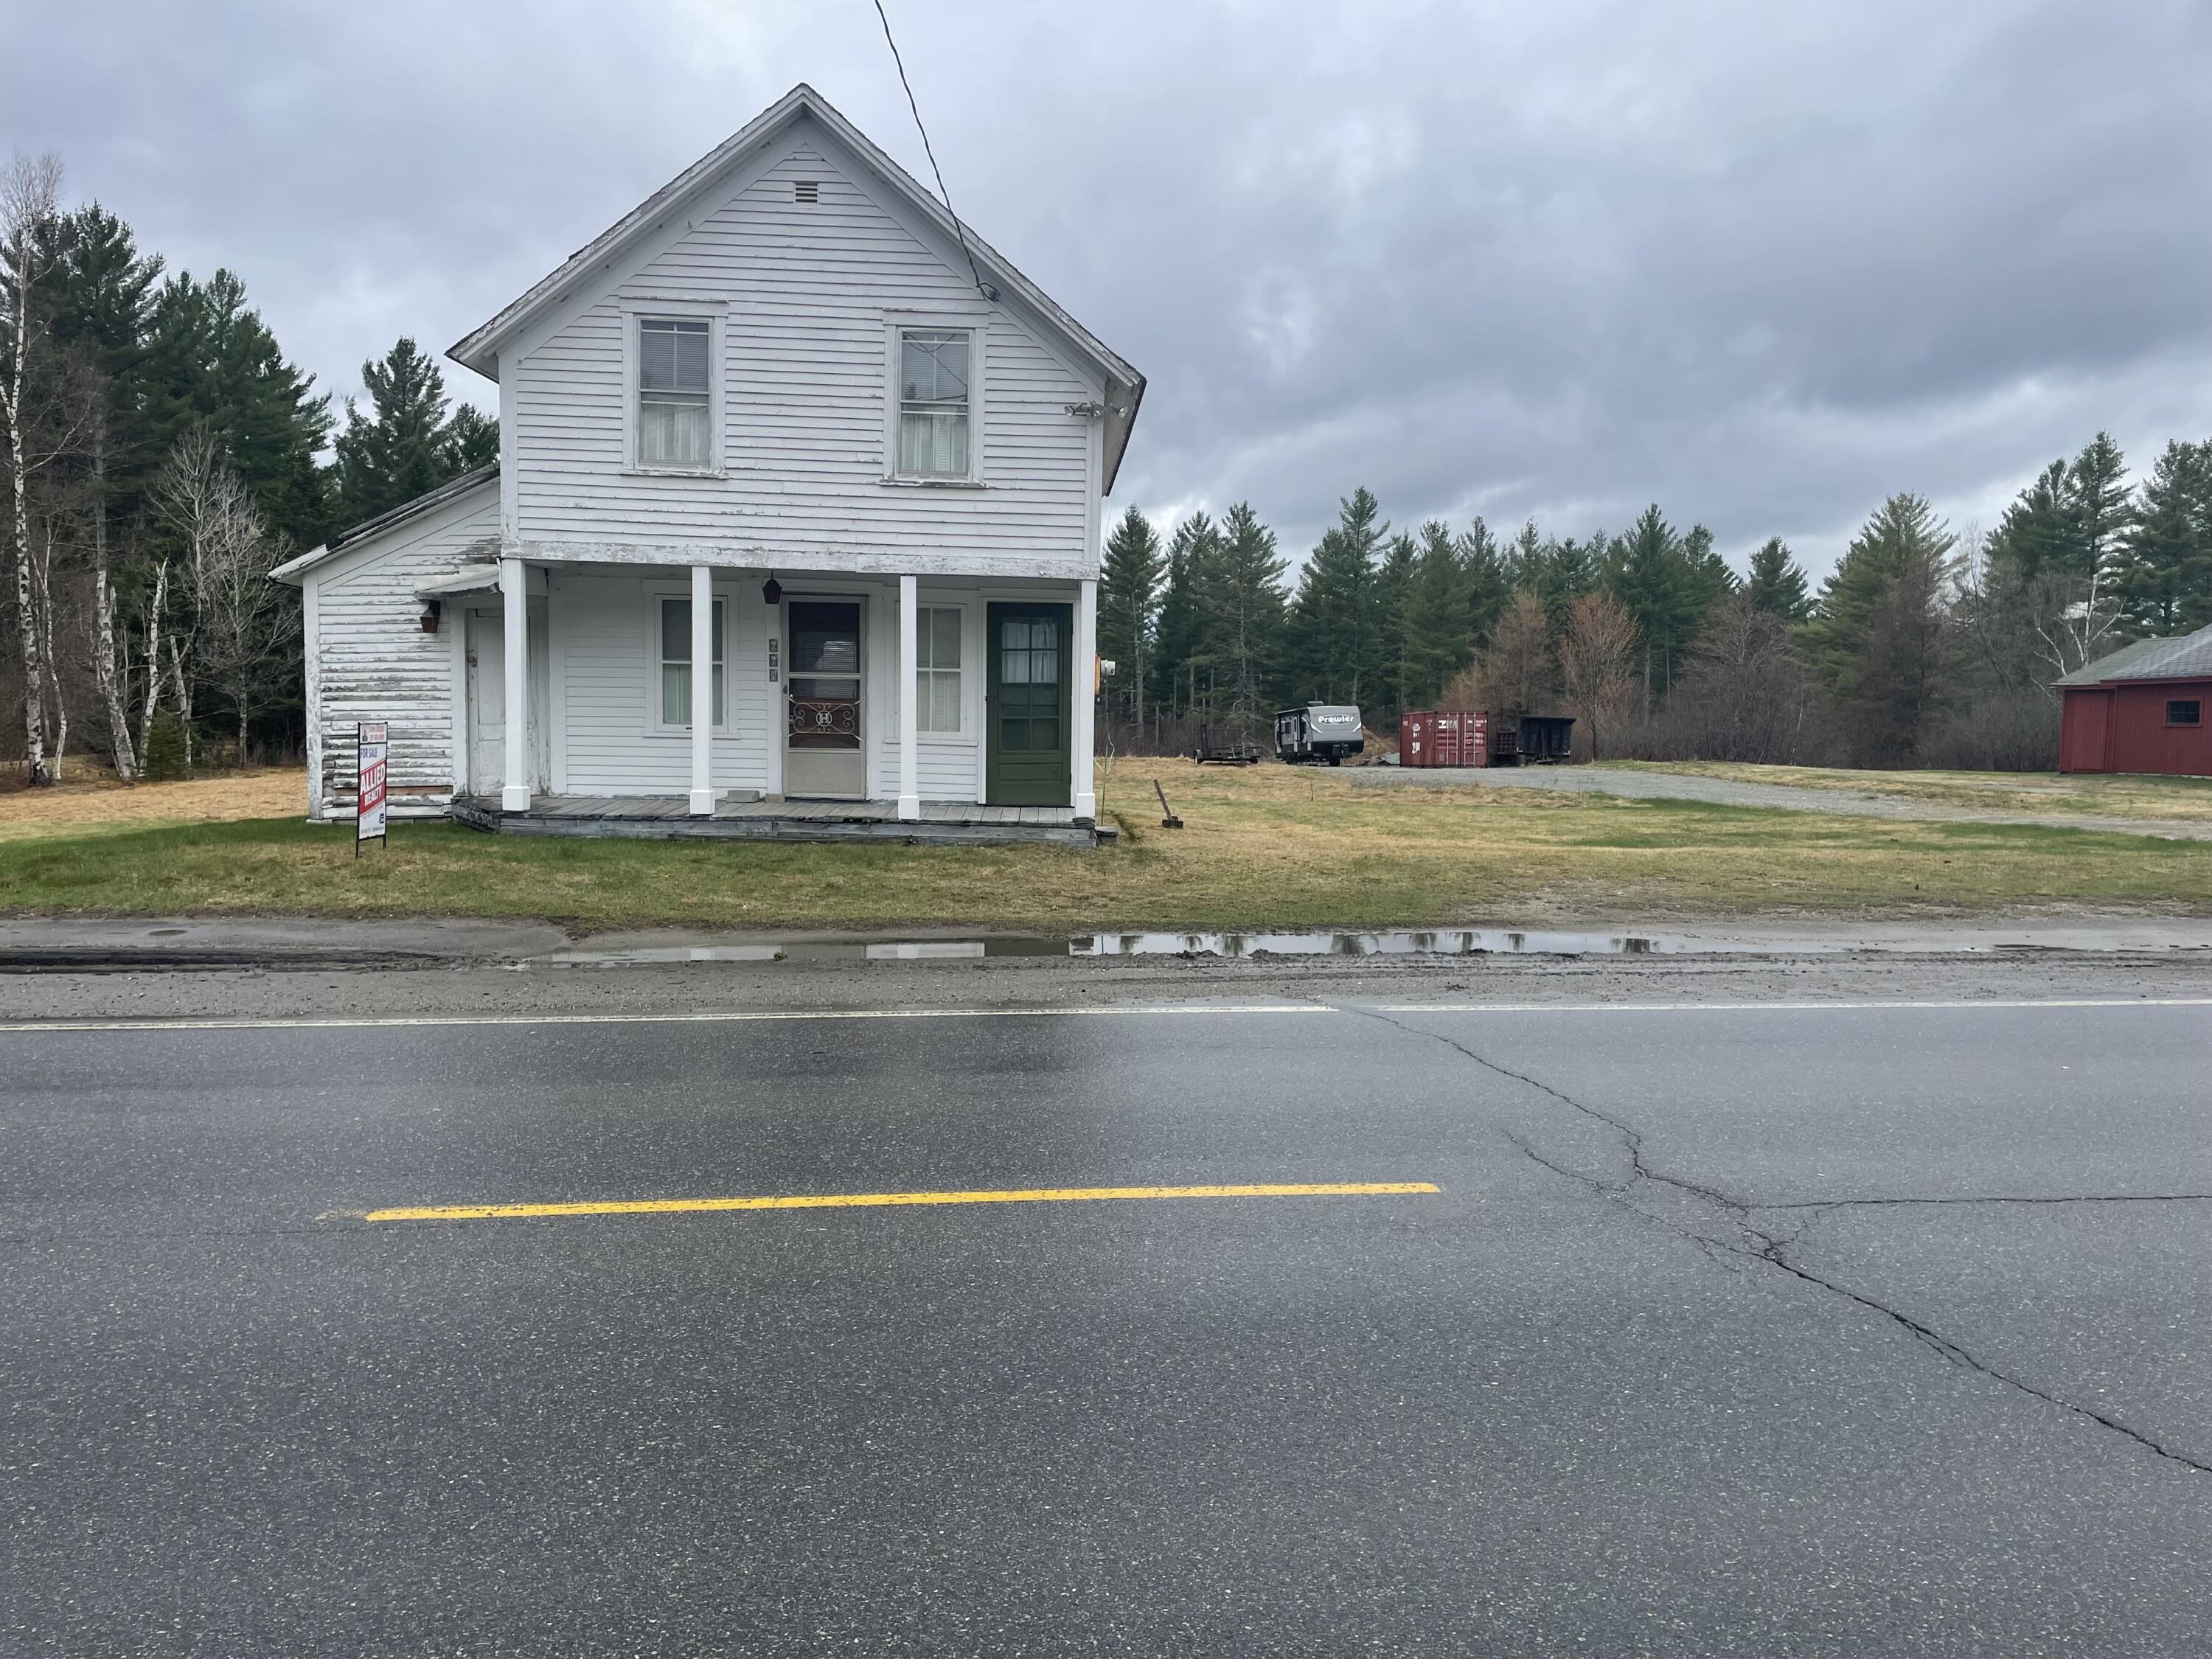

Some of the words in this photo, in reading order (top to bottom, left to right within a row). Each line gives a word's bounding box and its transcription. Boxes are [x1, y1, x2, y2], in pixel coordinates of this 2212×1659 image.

[819, 713, 830, 723] H
[369, 747, 377, 757] SALE
[361, 764, 385, 796] ALLIED
[364, 785, 382, 807] REALTY
